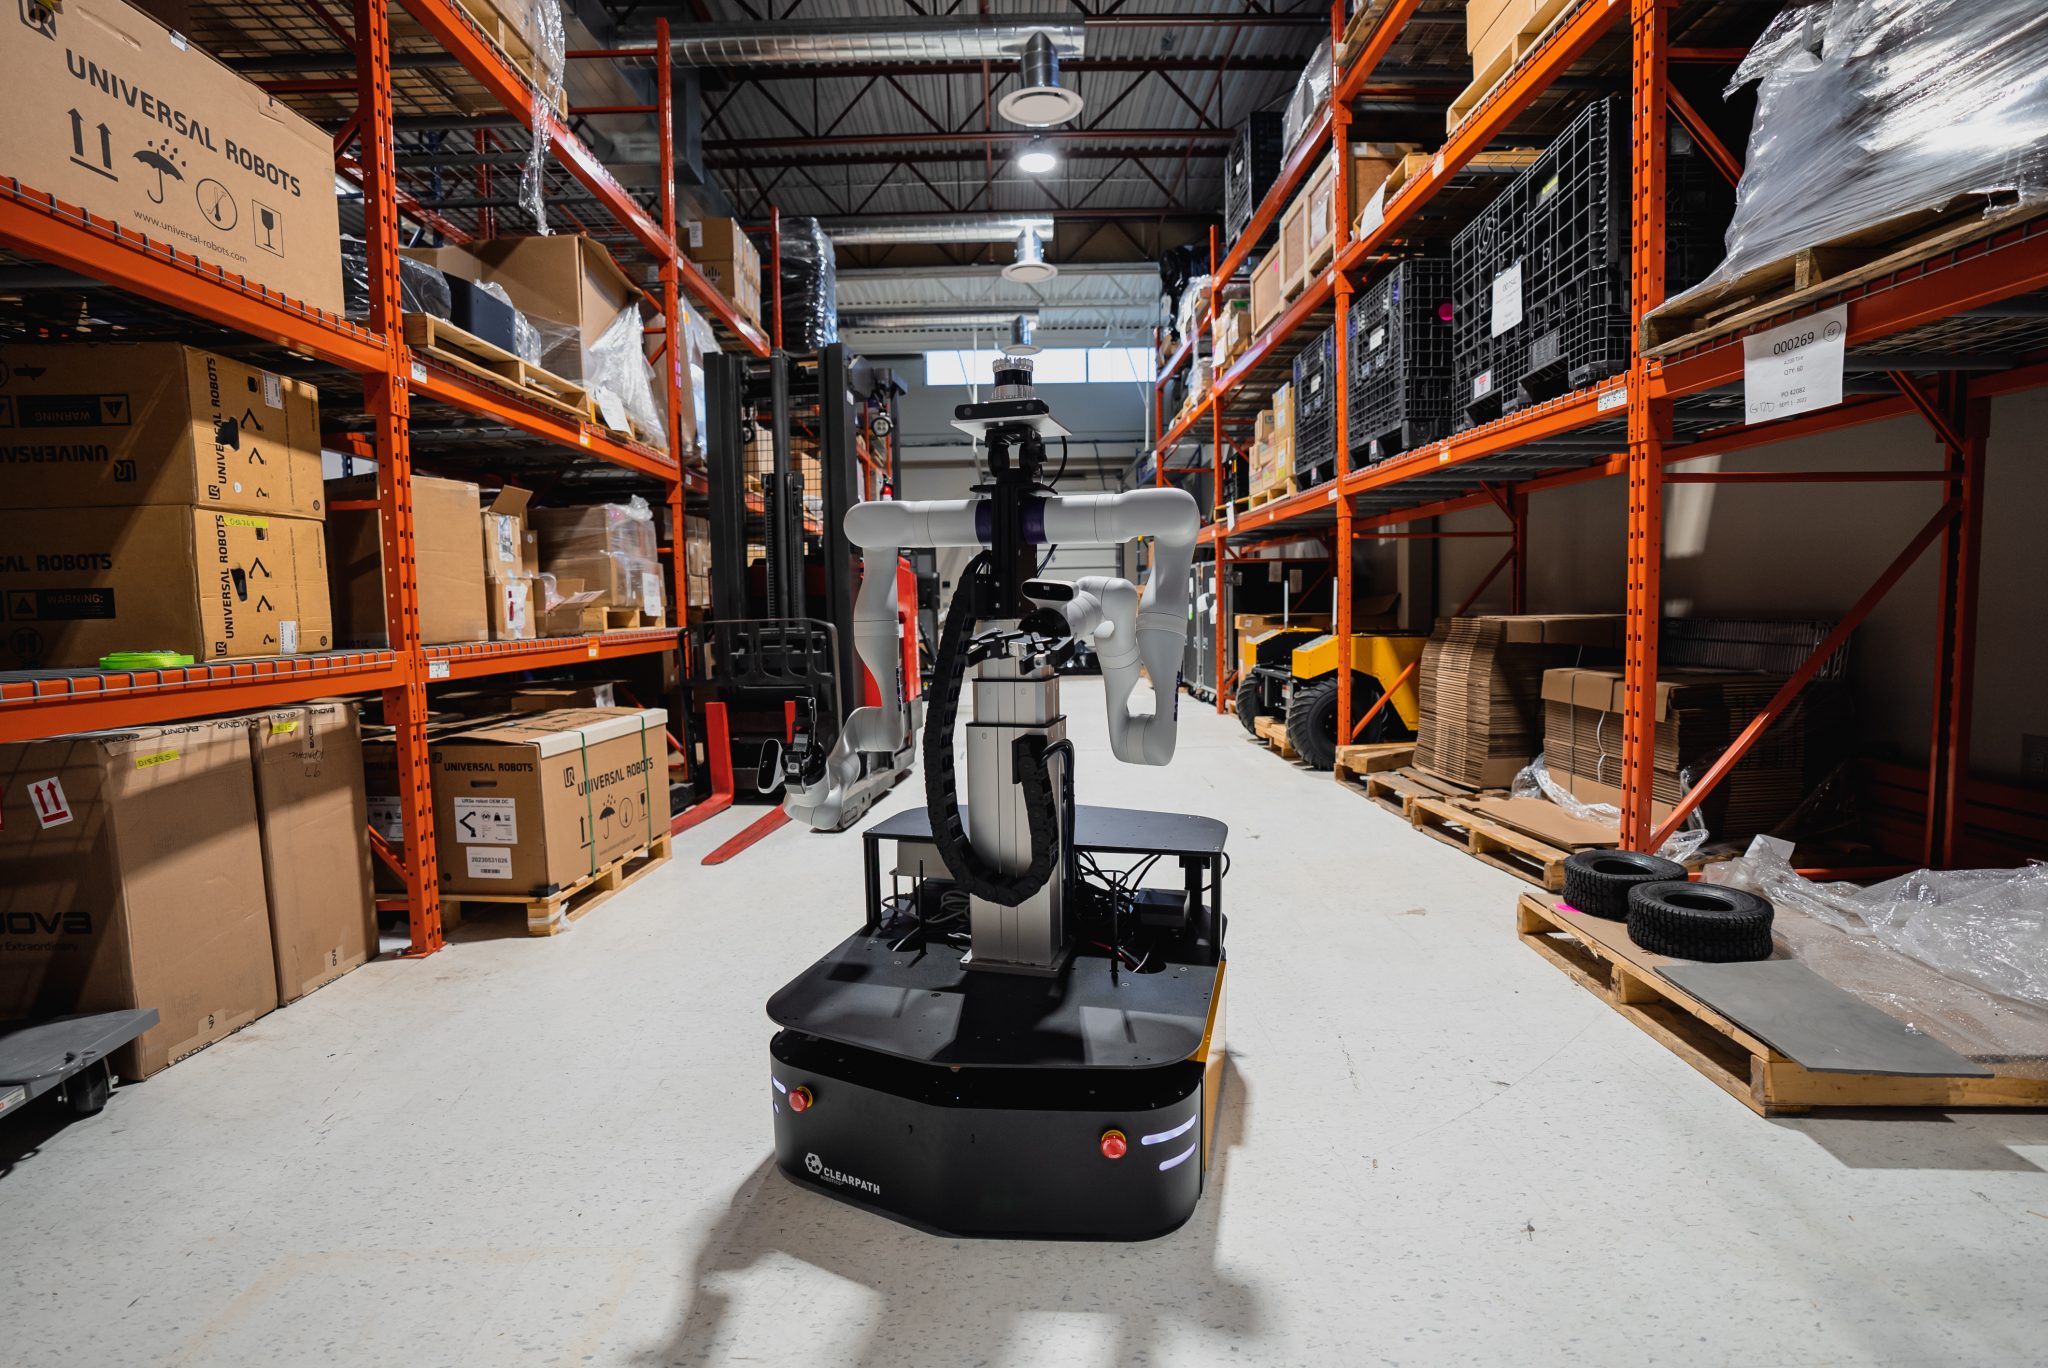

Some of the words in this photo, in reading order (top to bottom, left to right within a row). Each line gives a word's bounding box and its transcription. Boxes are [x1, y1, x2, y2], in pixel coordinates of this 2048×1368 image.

[65, 48, 217, 153] UNIVERSAL
[225, 138, 302, 198] ROBOTS
[133, 209, 248, 264] www.universal-robots.com
[1773, 331, 1815, 355] 000269
[207, 357, 220, 410] ROBOTS
[215, 515, 229, 563] ROBOTS
[36, 553, 113, 572] ROBOTS
[220, 567, 235, 639] UNIVERSAL
[444, 762, 496, 772] UNIVERSAL
[498, 763, 534, 772] ROBOTS
[563, 766, 575, 788] UR
[823, 1166, 881, 1195] CLEARPATH
